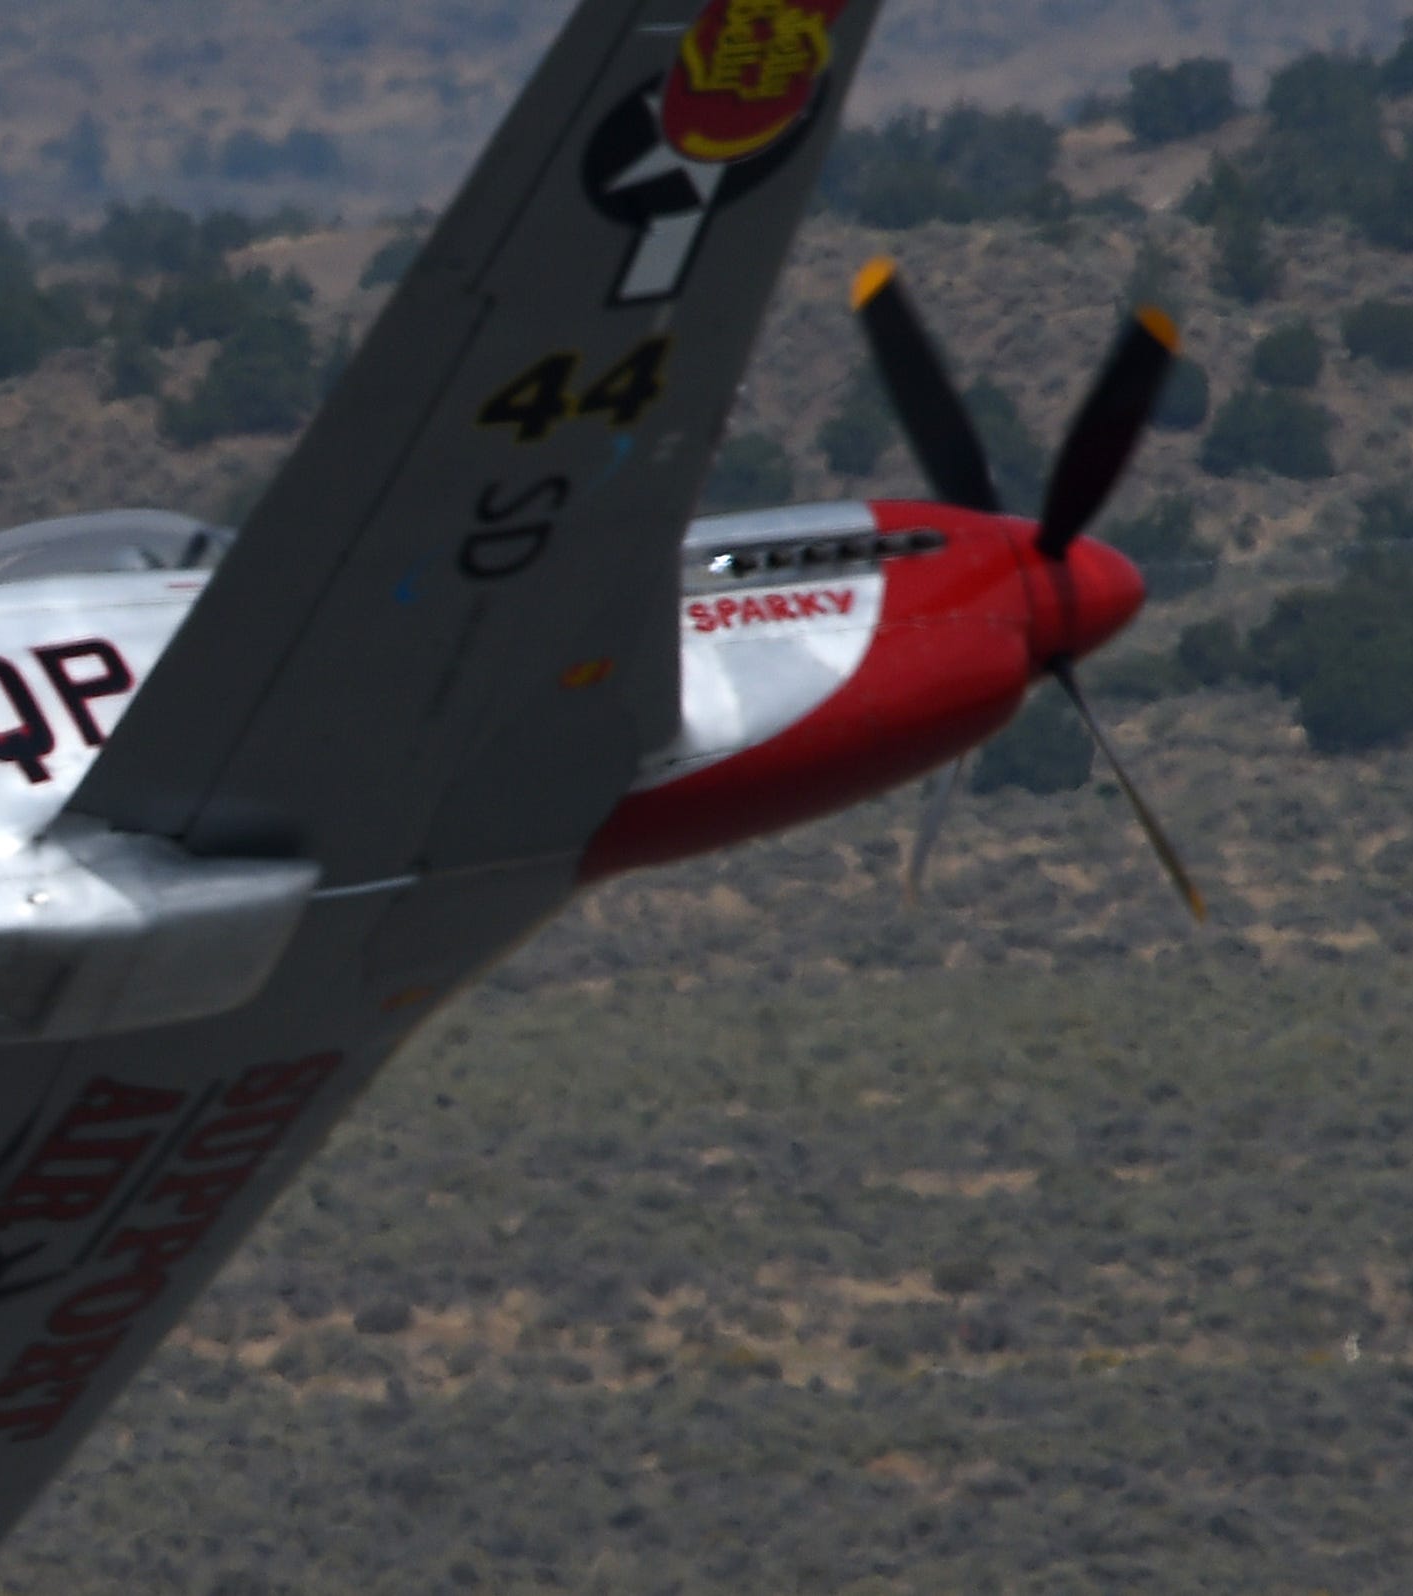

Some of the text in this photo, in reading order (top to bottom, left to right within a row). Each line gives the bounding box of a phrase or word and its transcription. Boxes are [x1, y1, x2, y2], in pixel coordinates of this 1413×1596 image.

[475, 335, 675, 444] 44
[458, 475, 569, 578] SD
[689, 589, 853, 632] SPARKY
